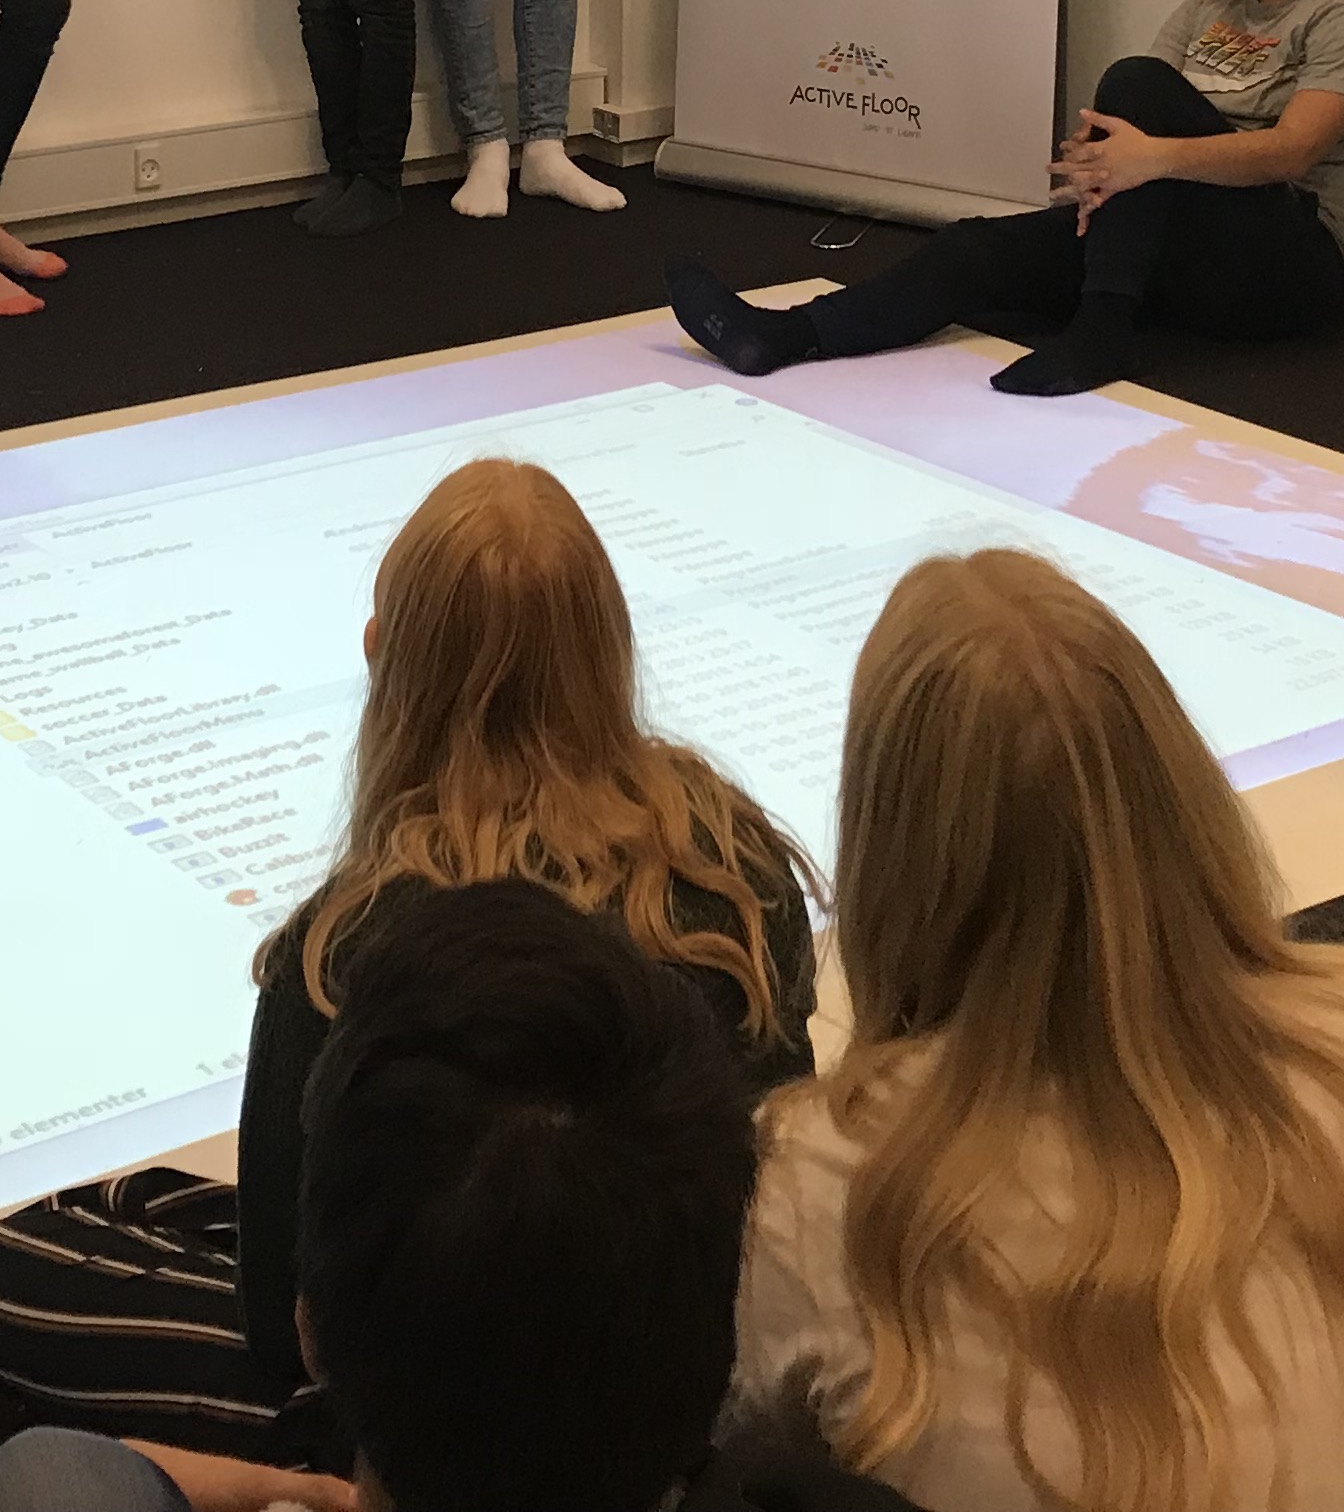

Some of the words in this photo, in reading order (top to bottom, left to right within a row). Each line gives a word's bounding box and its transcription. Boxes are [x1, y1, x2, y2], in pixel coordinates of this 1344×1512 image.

[861, 92, 923, 131] FLOOR
[18, 686, 126, 716] Resources
[174, 789, 279, 823] airhockey
[193, 808, 296, 840] BikeRace
[9, 1088, 146, 1139] elementer
